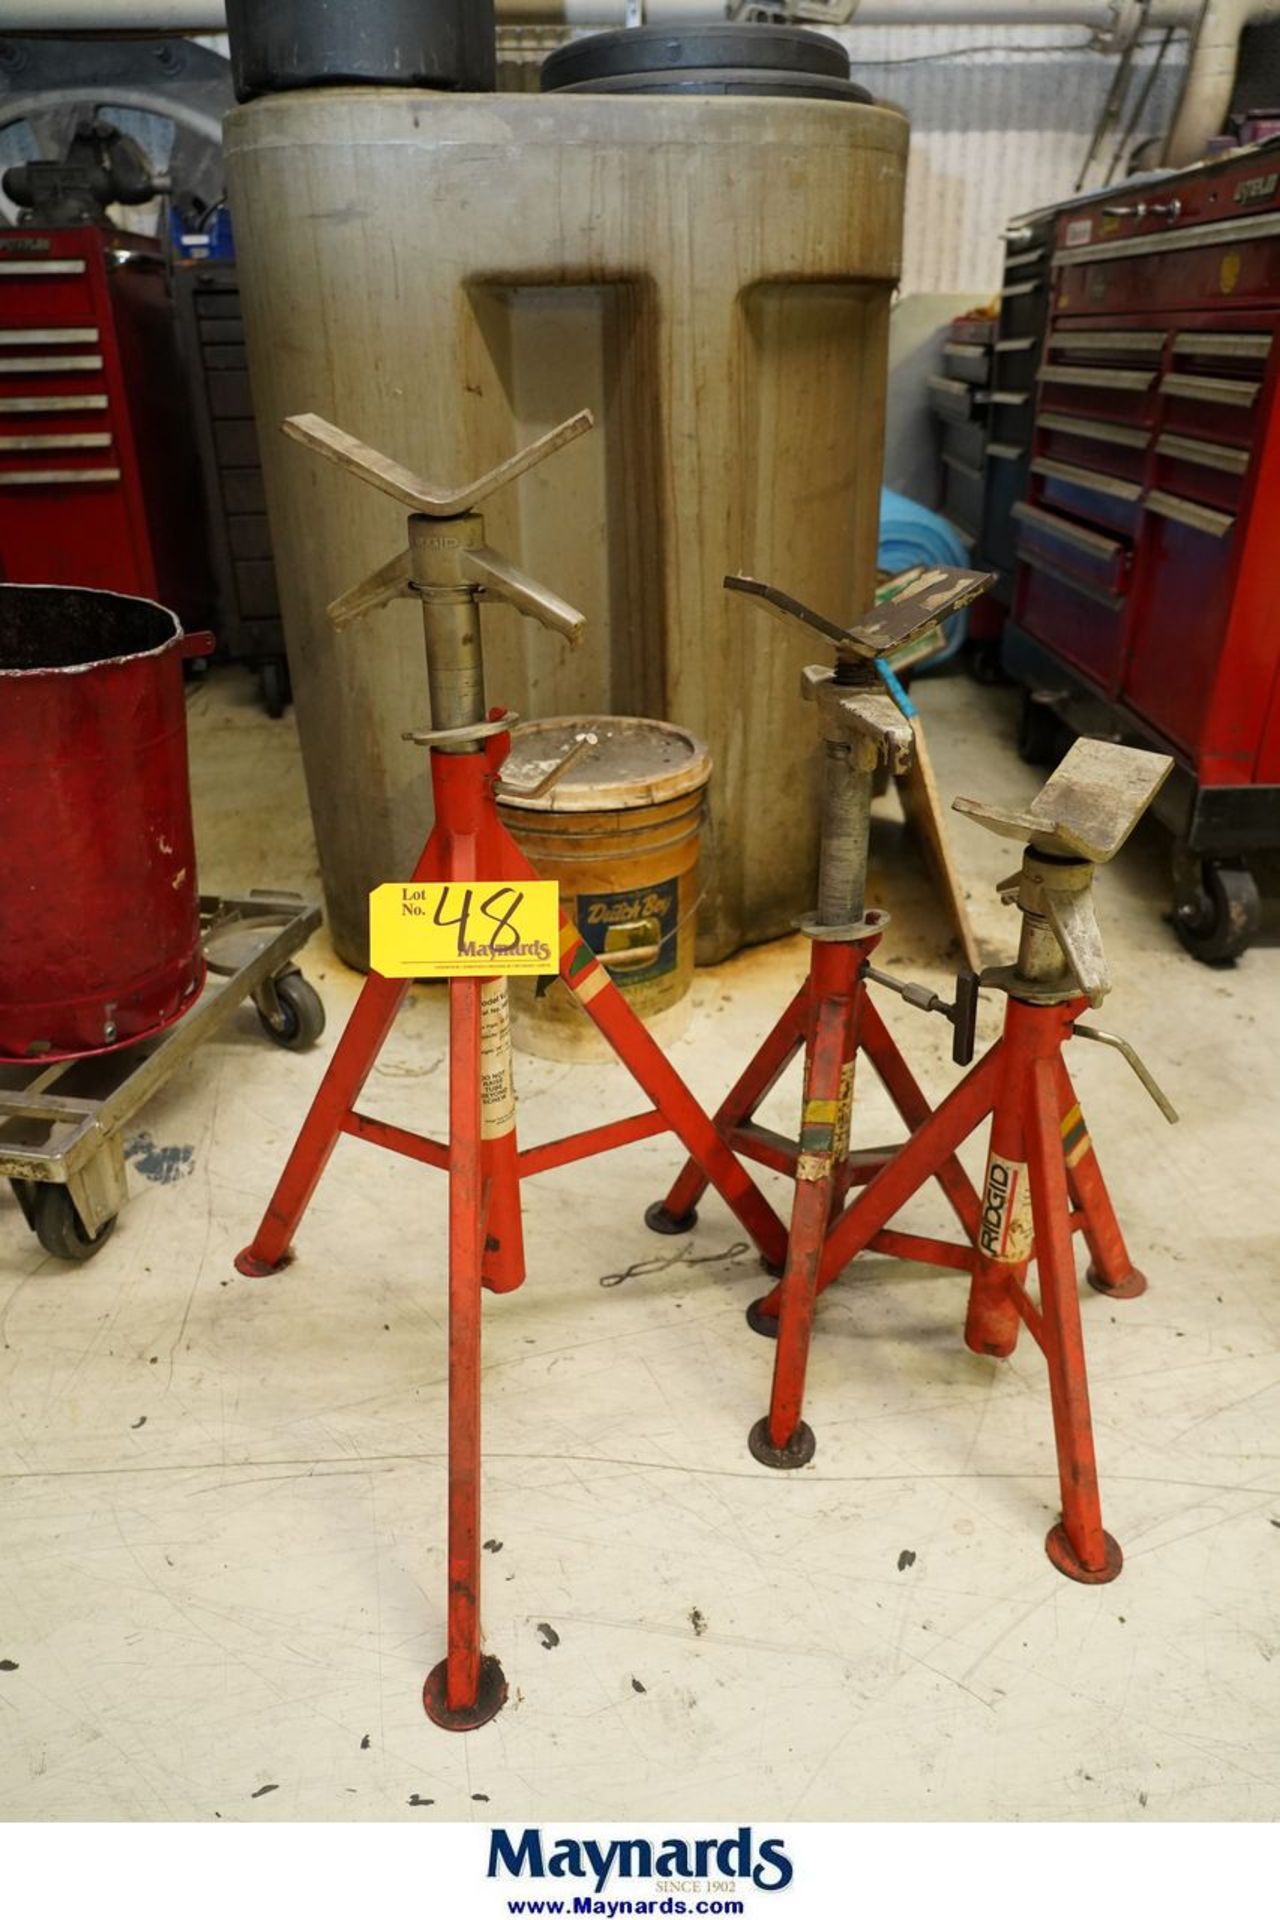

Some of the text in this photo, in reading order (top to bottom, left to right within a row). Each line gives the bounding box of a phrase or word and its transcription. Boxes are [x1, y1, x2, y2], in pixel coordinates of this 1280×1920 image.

[402, 887, 426, 901] Lot
[402, 903, 426, 916] No.
[433, 886, 524, 952] 48
[587, 892, 672, 925] Dutch Boy
[457, 939, 552, 961] Maynards
[981, 1164, 1008, 1255] RIDGID
